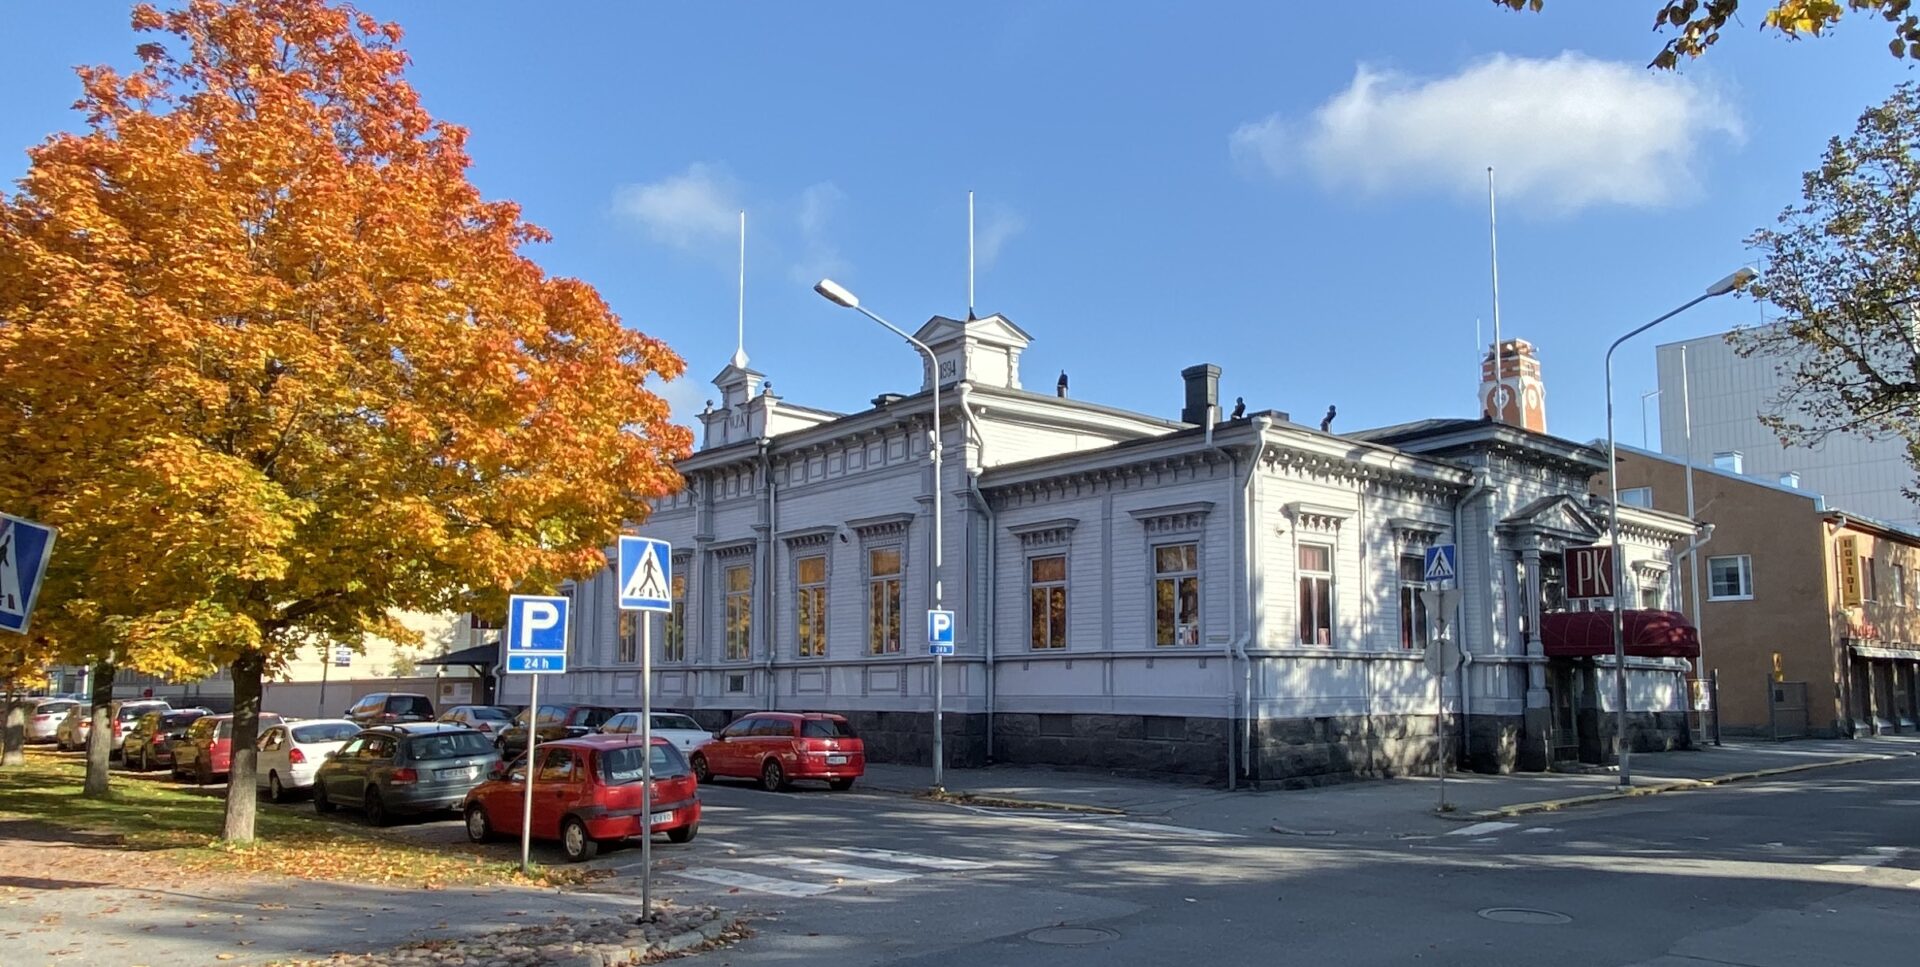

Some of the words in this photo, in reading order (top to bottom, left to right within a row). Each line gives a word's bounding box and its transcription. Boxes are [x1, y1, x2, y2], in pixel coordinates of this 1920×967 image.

[940, 359, 956, 379] 1894
[1577, 549, 1610, 596] PK
[521, 601, 559, 648] P
[933, 613, 950, 641] P
[524, 657, 539, 669] 24
[542, 657, 550, 669] h
